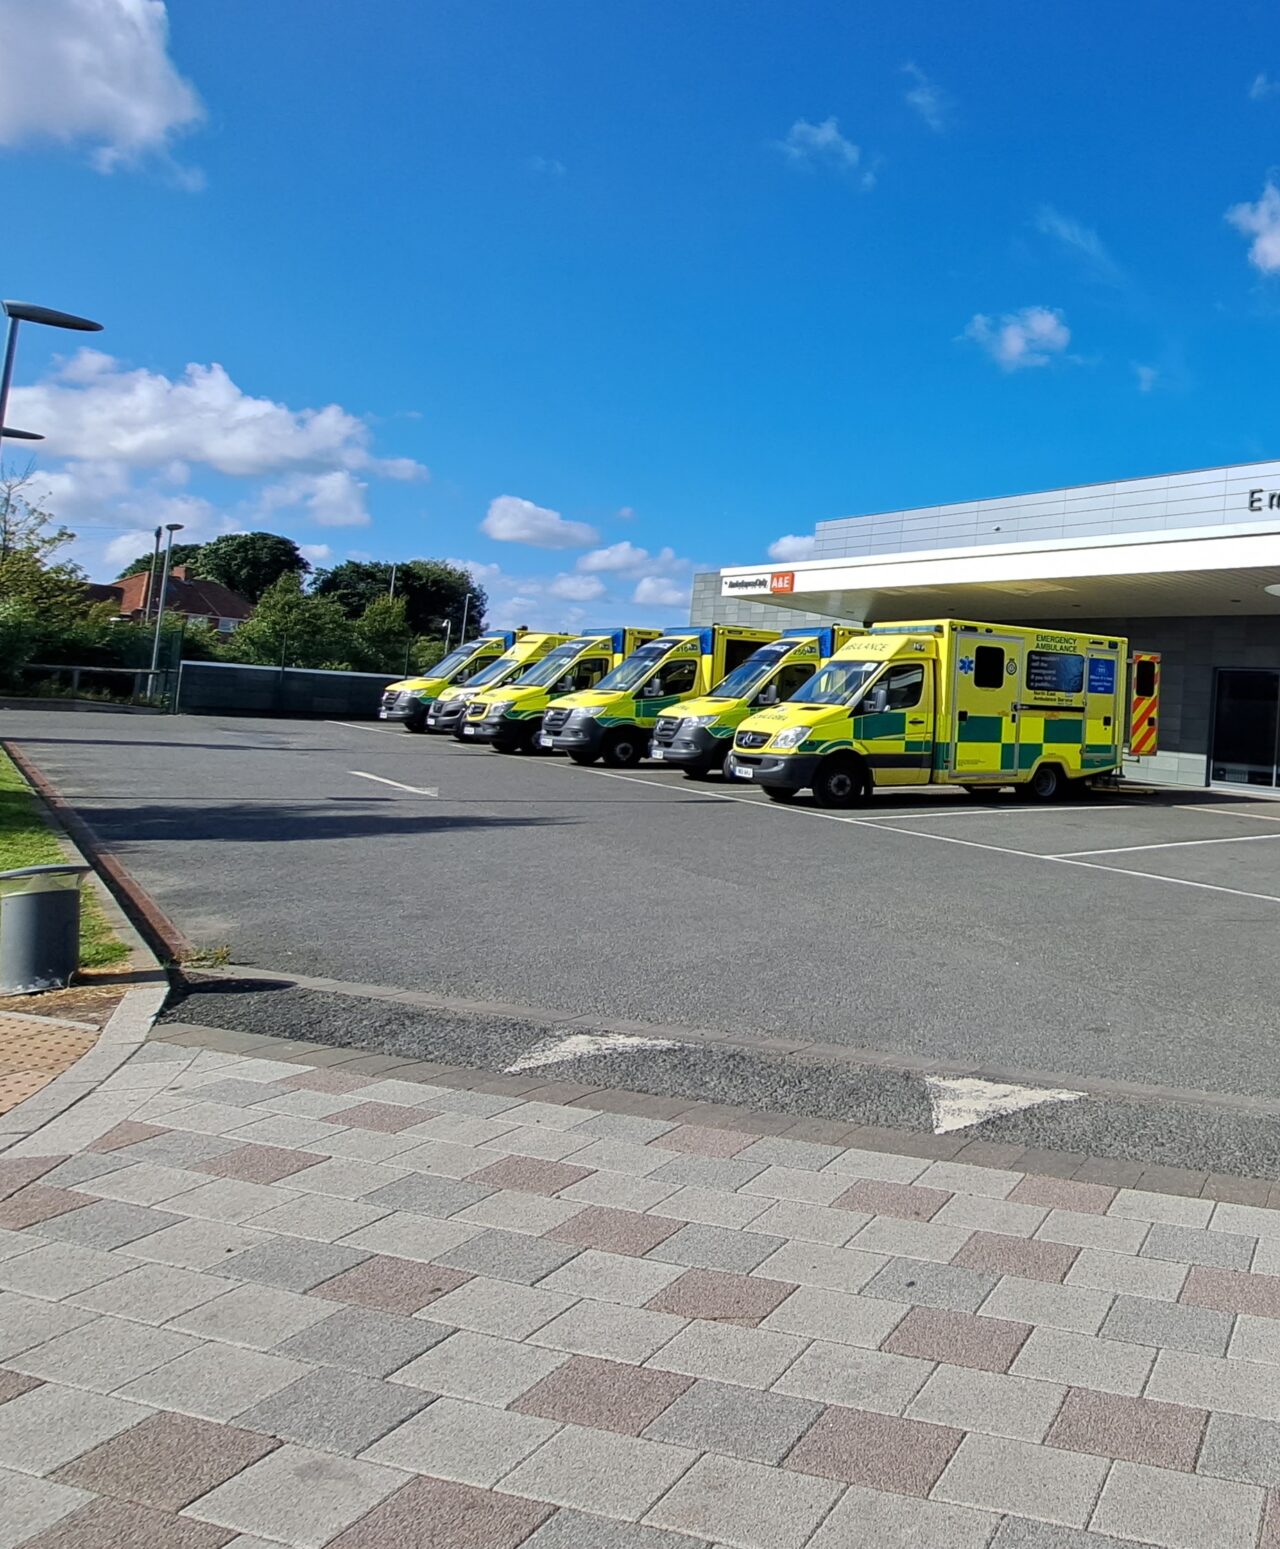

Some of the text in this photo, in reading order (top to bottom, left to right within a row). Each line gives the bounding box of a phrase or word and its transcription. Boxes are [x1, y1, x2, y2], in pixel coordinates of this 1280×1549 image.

[771, 576, 790, 588] A&E
[1036, 634, 1077, 644] EMERGENCY
[1035, 643, 1078, 652] AMBULANCE
